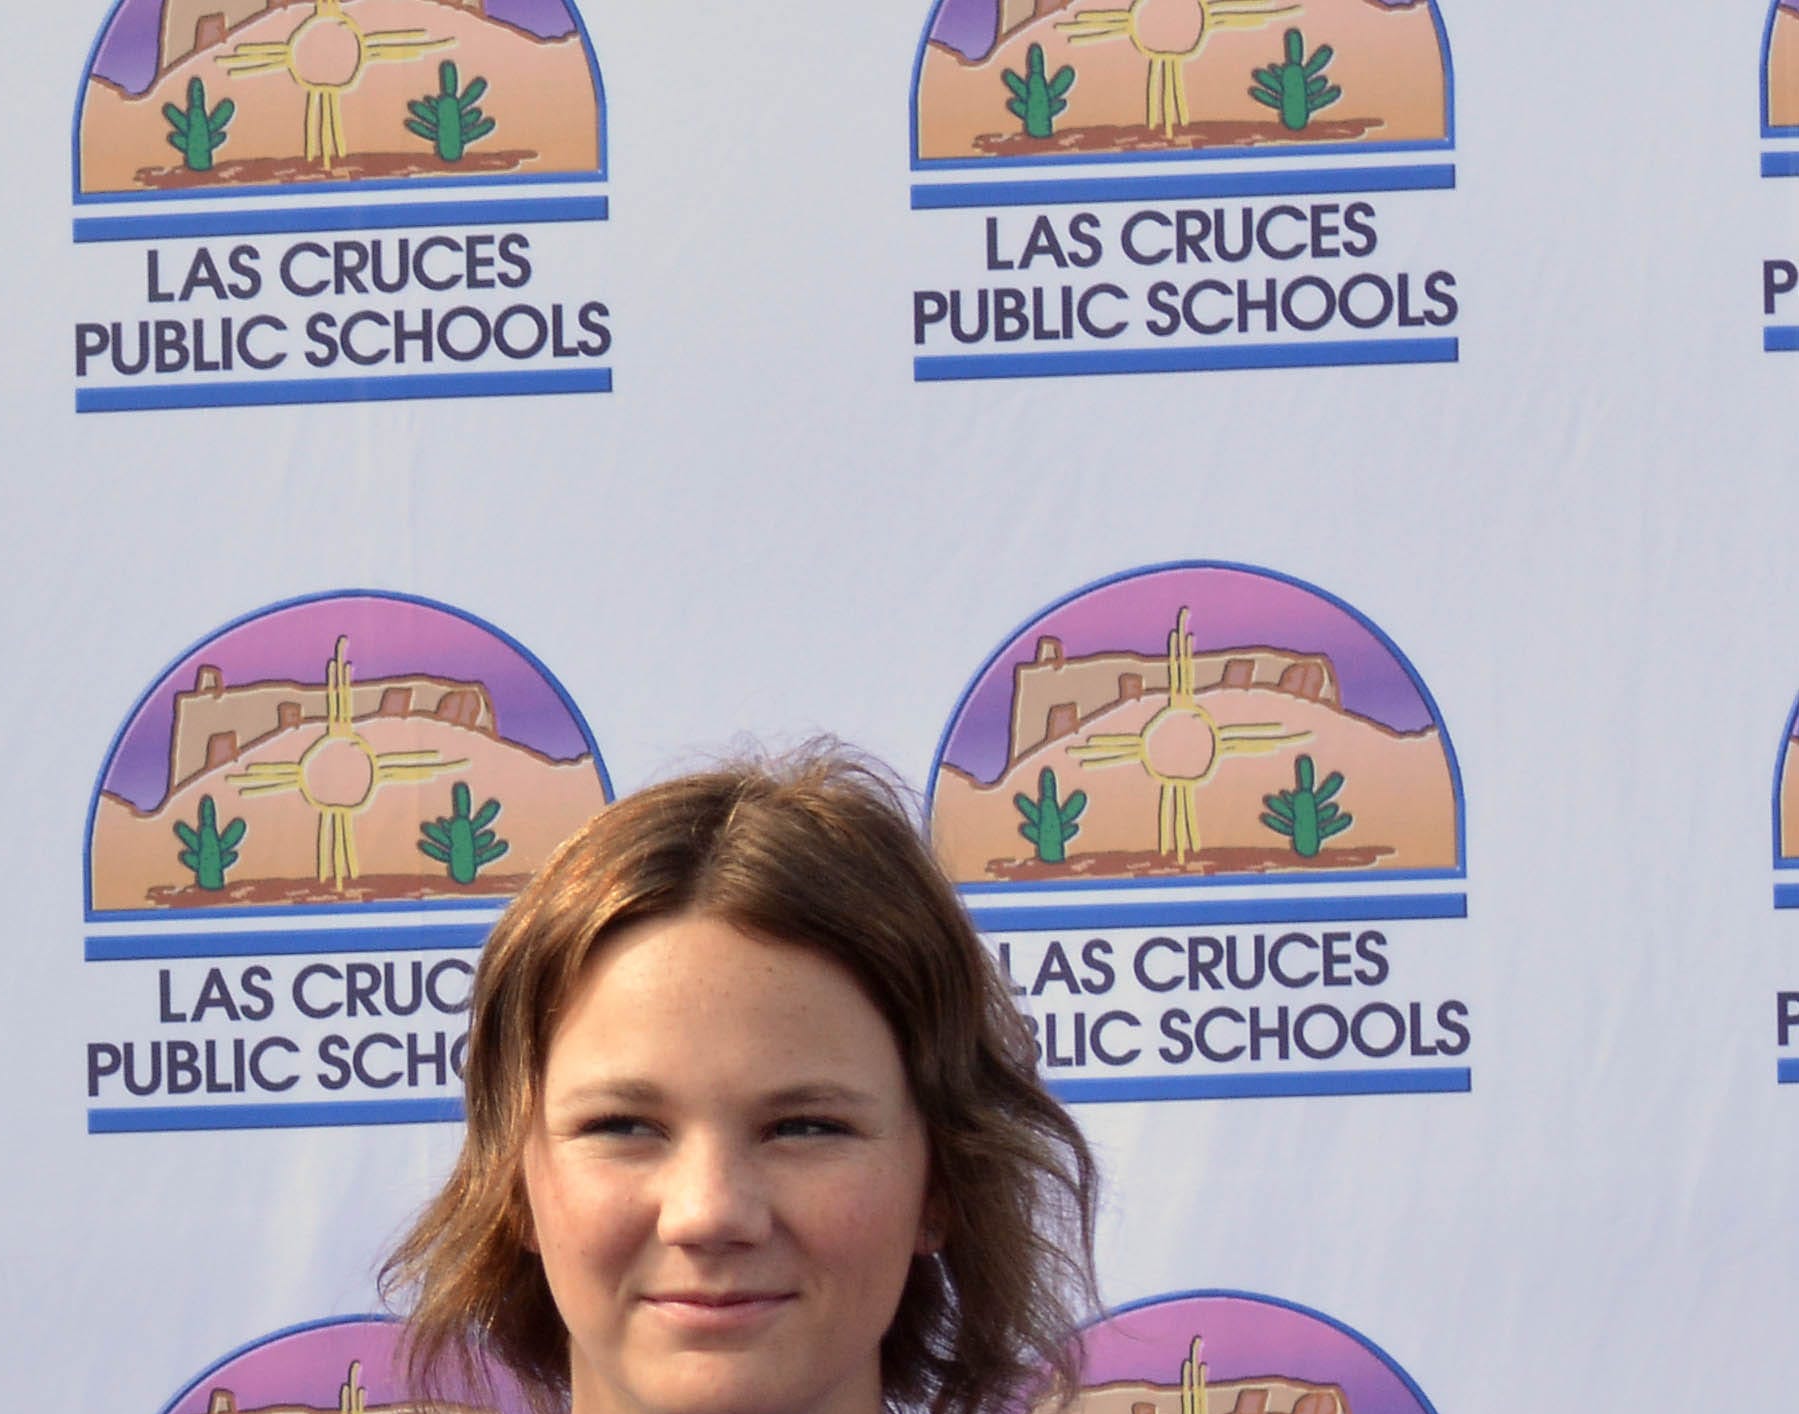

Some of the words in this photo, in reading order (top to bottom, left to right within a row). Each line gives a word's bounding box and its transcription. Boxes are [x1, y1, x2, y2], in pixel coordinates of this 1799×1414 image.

[148, 245, 261, 302] LAS
[280, 233, 531, 297] CRUCES
[987, 213, 1102, 270] LAS
[1121, 202, 1377, 265] CRUCES
[76, 315, 287, 376] PUBLIC
[305, 302, 611, 367] SCHOOLS
[914, 284, 1128, 344] PUBLIC
[1147, 271, 1458, 336] SCHOOLS
[160, 966, 273, 1022] LAS
[293, 958, 475, 1018] CRUC
[999, 938, 1115, 995] LAS
[1134, 931, 1389, 992] CRUCES
[88, 1037, 299, 1096] PUBLIC
[1024, 1010, 1141, 1067] LIC
[1159, 1001, 1470, 1063] SCHOOLS
